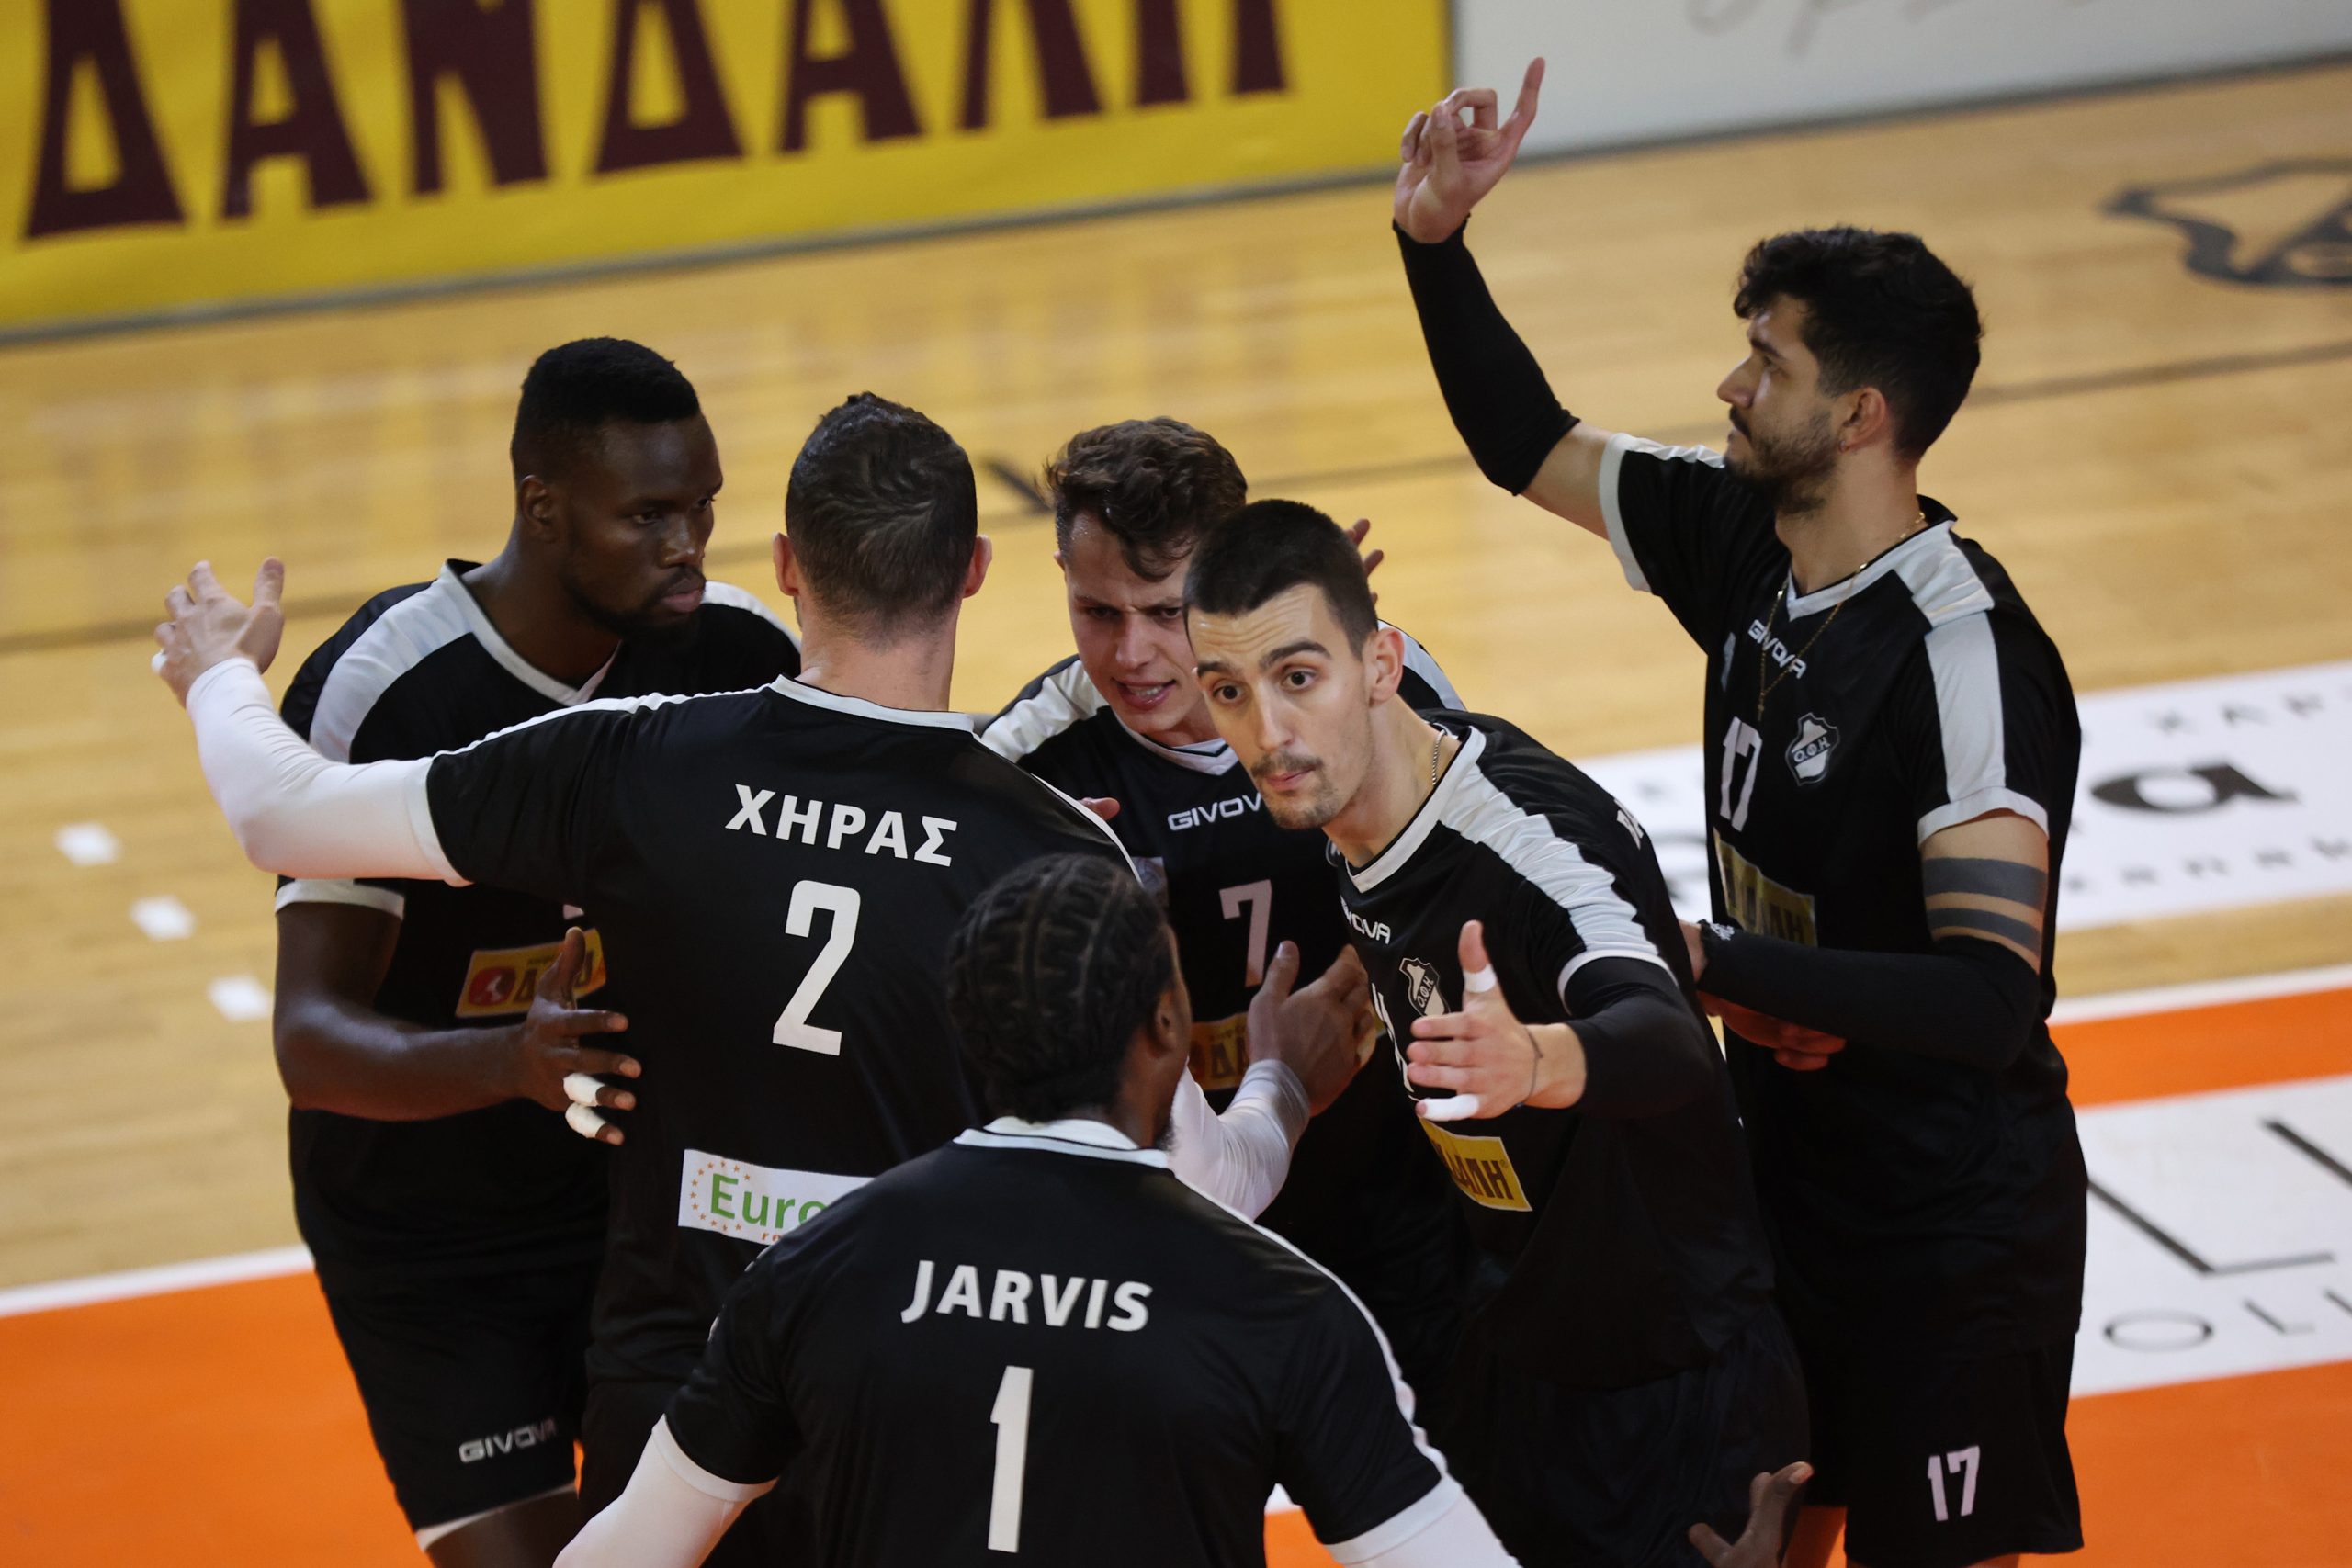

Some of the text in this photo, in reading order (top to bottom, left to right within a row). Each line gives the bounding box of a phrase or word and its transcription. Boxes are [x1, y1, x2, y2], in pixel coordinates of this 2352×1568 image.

[1747, 618, 1807, 679] GIVOVA
[1167, 791, 1262, 831] GIVOV
[1719, 716, 1763, 833] 17
[724, 783, 958, 868] ΧΗΡΑΣ
[772, 879, 862, 1057] 2
[1218, 878, 1273, 988] 7
[899, 1258, 1154, 1333] JARVIS
[987, 1364, 1035, 1554] 1
[1927, 1444, 1982, 1522] 17
